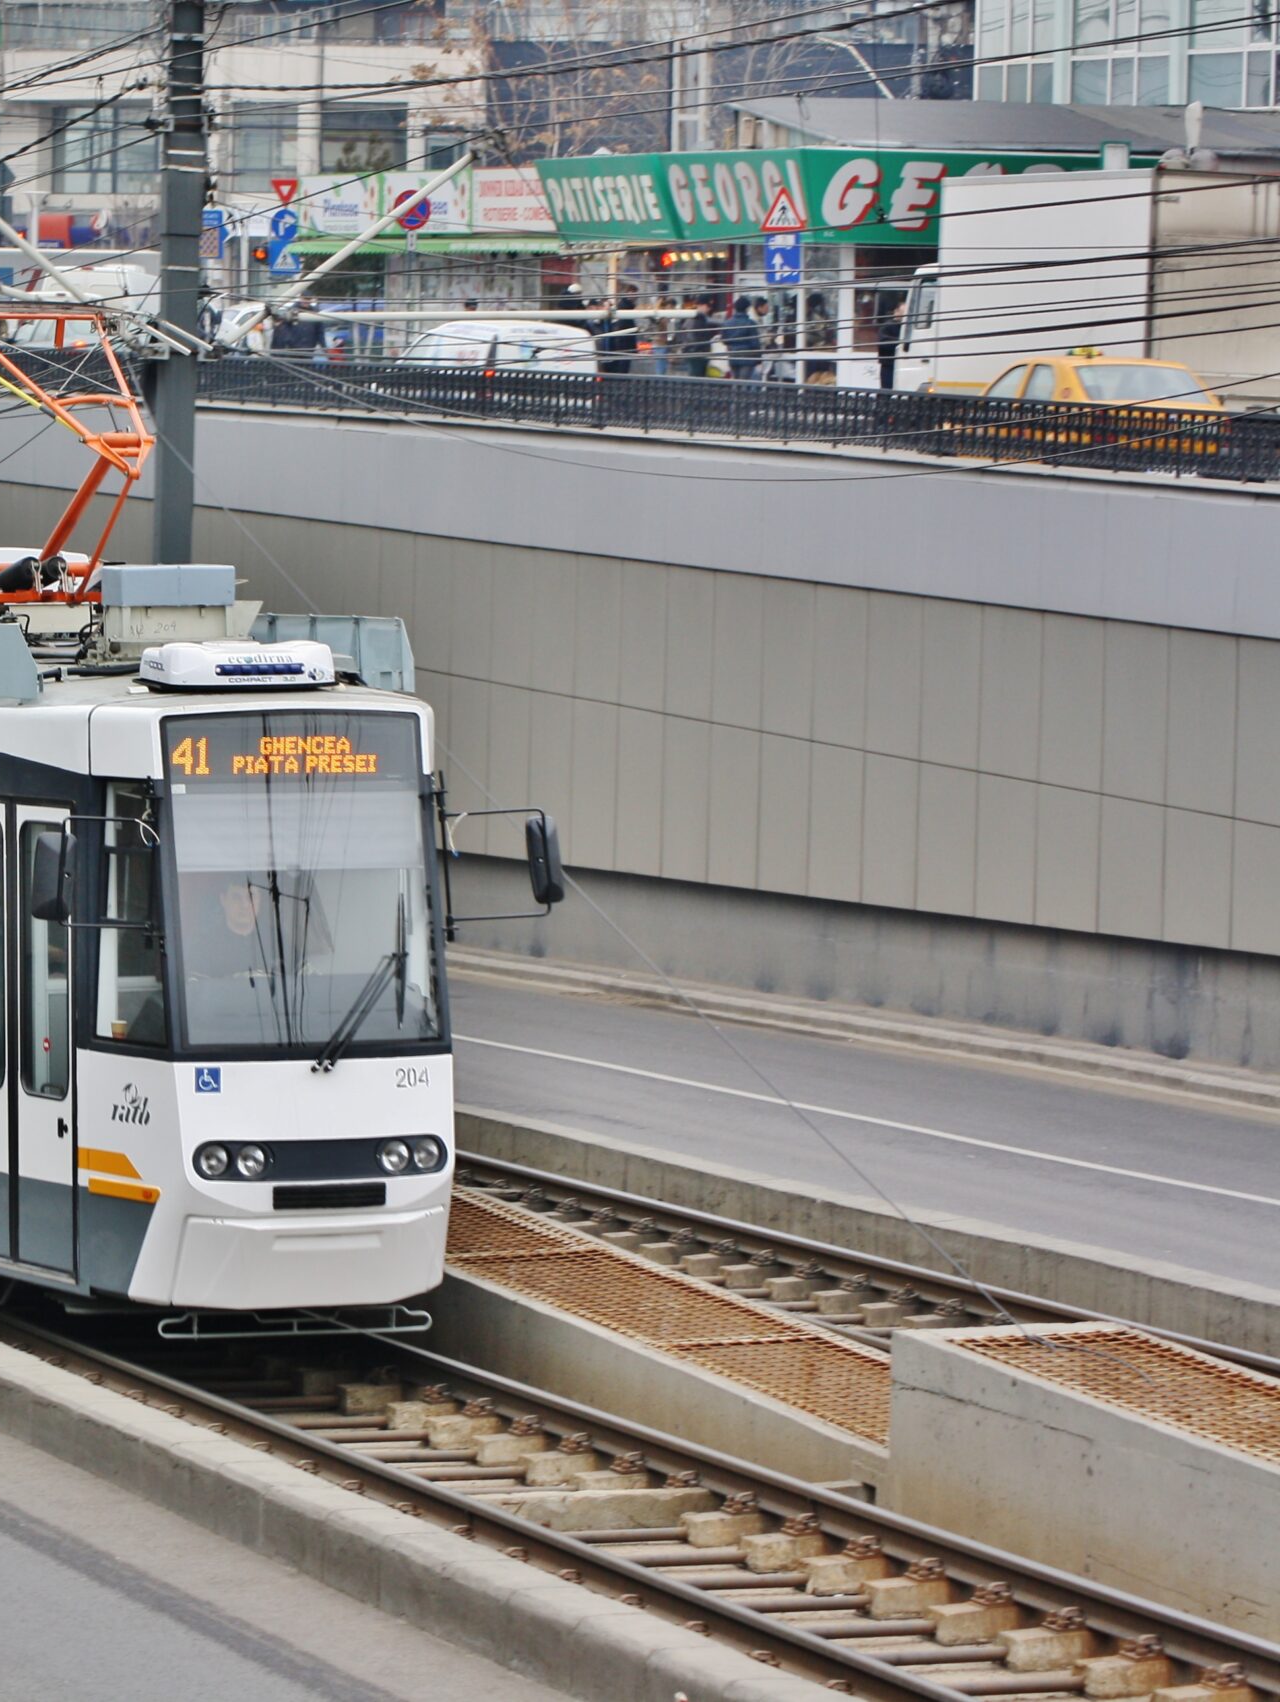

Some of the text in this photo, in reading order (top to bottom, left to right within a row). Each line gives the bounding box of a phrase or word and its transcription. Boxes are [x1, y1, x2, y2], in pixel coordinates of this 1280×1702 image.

[545, 174, 662, 225] PATISERIE
[172, 737, 210, 775] 41
[260, 736, 351, 755] GHENCEA
[232, 754, 377, 775] PIATA PRESEI
[395, 1068, 430, 1088] 204
